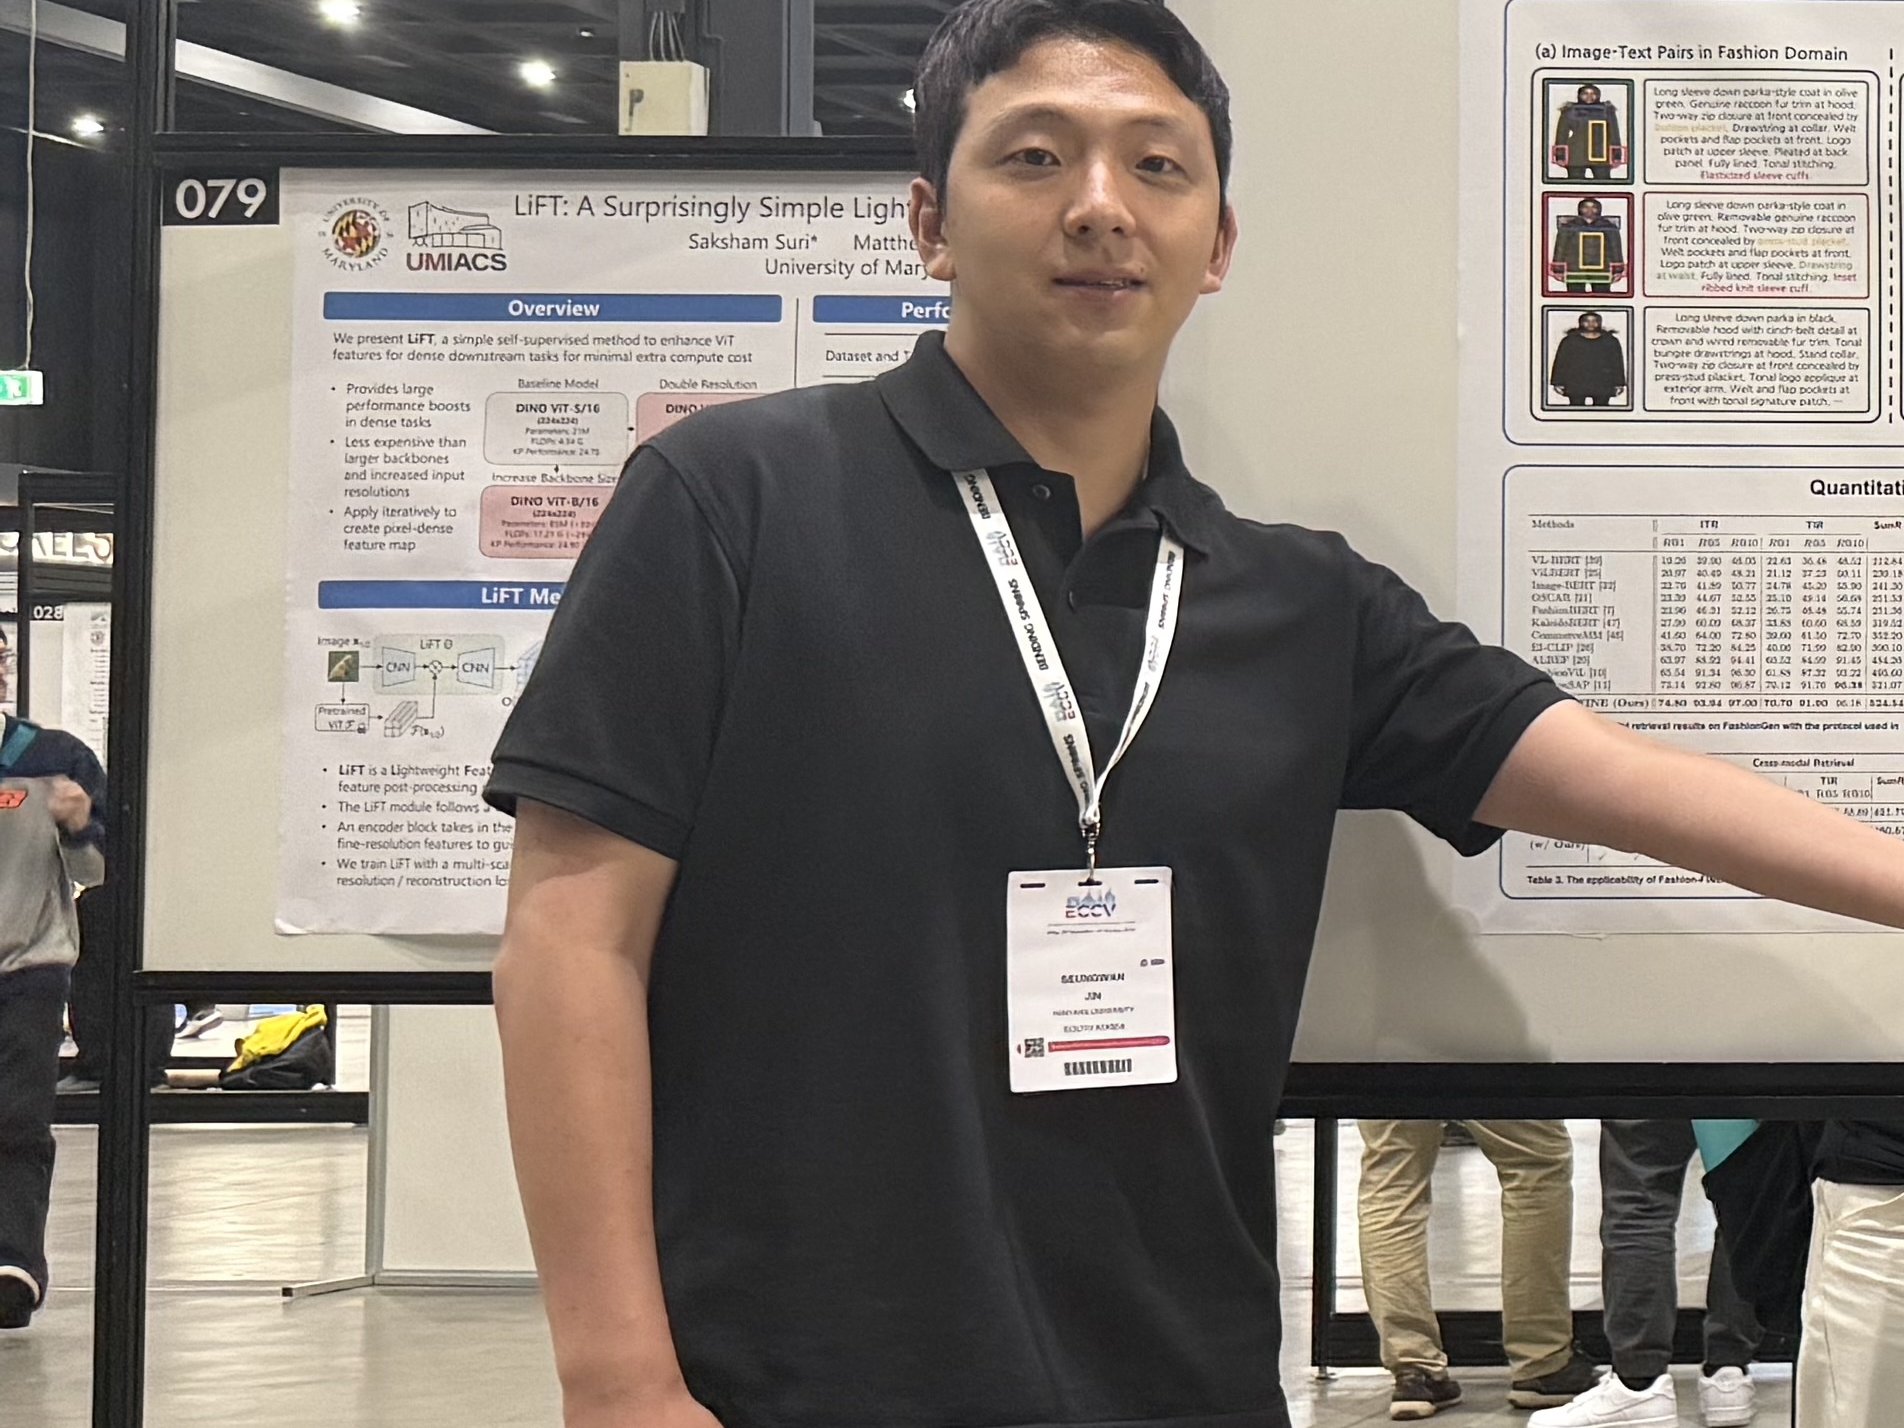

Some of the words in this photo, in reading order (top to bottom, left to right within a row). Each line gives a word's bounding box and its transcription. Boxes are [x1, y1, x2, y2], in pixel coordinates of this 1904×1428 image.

[1535, 43, 1556, 60] (a)
[1562, 45, 1652, 61] Image-Text
[1658, 44, 1694, 60] Pairs
[1698, 44, 1712, 59] in
[1718, 45, 1778, 59] Fashion
[1785, 46, 1848, 61] Domain
[176, 178, 266, 219] 079
[515, 194, 568, 216] LiFT:
[576, 195, 595, 217] A
[603, 194, 751, 224] Surprisingly
[759, 191, 844, 225] Simple
[688, 232, 768, 250] Saksham
[406, 252, 507, 271] UMIACS
[765, 258, 855, 280] University
[861, 258, 879, 276] of
[508, 299, 600, 316] Overview
[345, 436, 370, 448] Less
[373, 436, 435, 450] expensive
[439, 436, 466, 448] than
[344, 452, 380, 468] larger
[383, 452, 449, 464] backbones
[344, 469, 367, 481] and
[371, 469, 428, 481] increased
[432, 469, 465, 483] input
[344, 485, 410, 497] resolutions
[482, 587, 524, 604] LiFT
[33, 604, 64, 620] 028
[1065, 903, 1117, 919] ECCV
